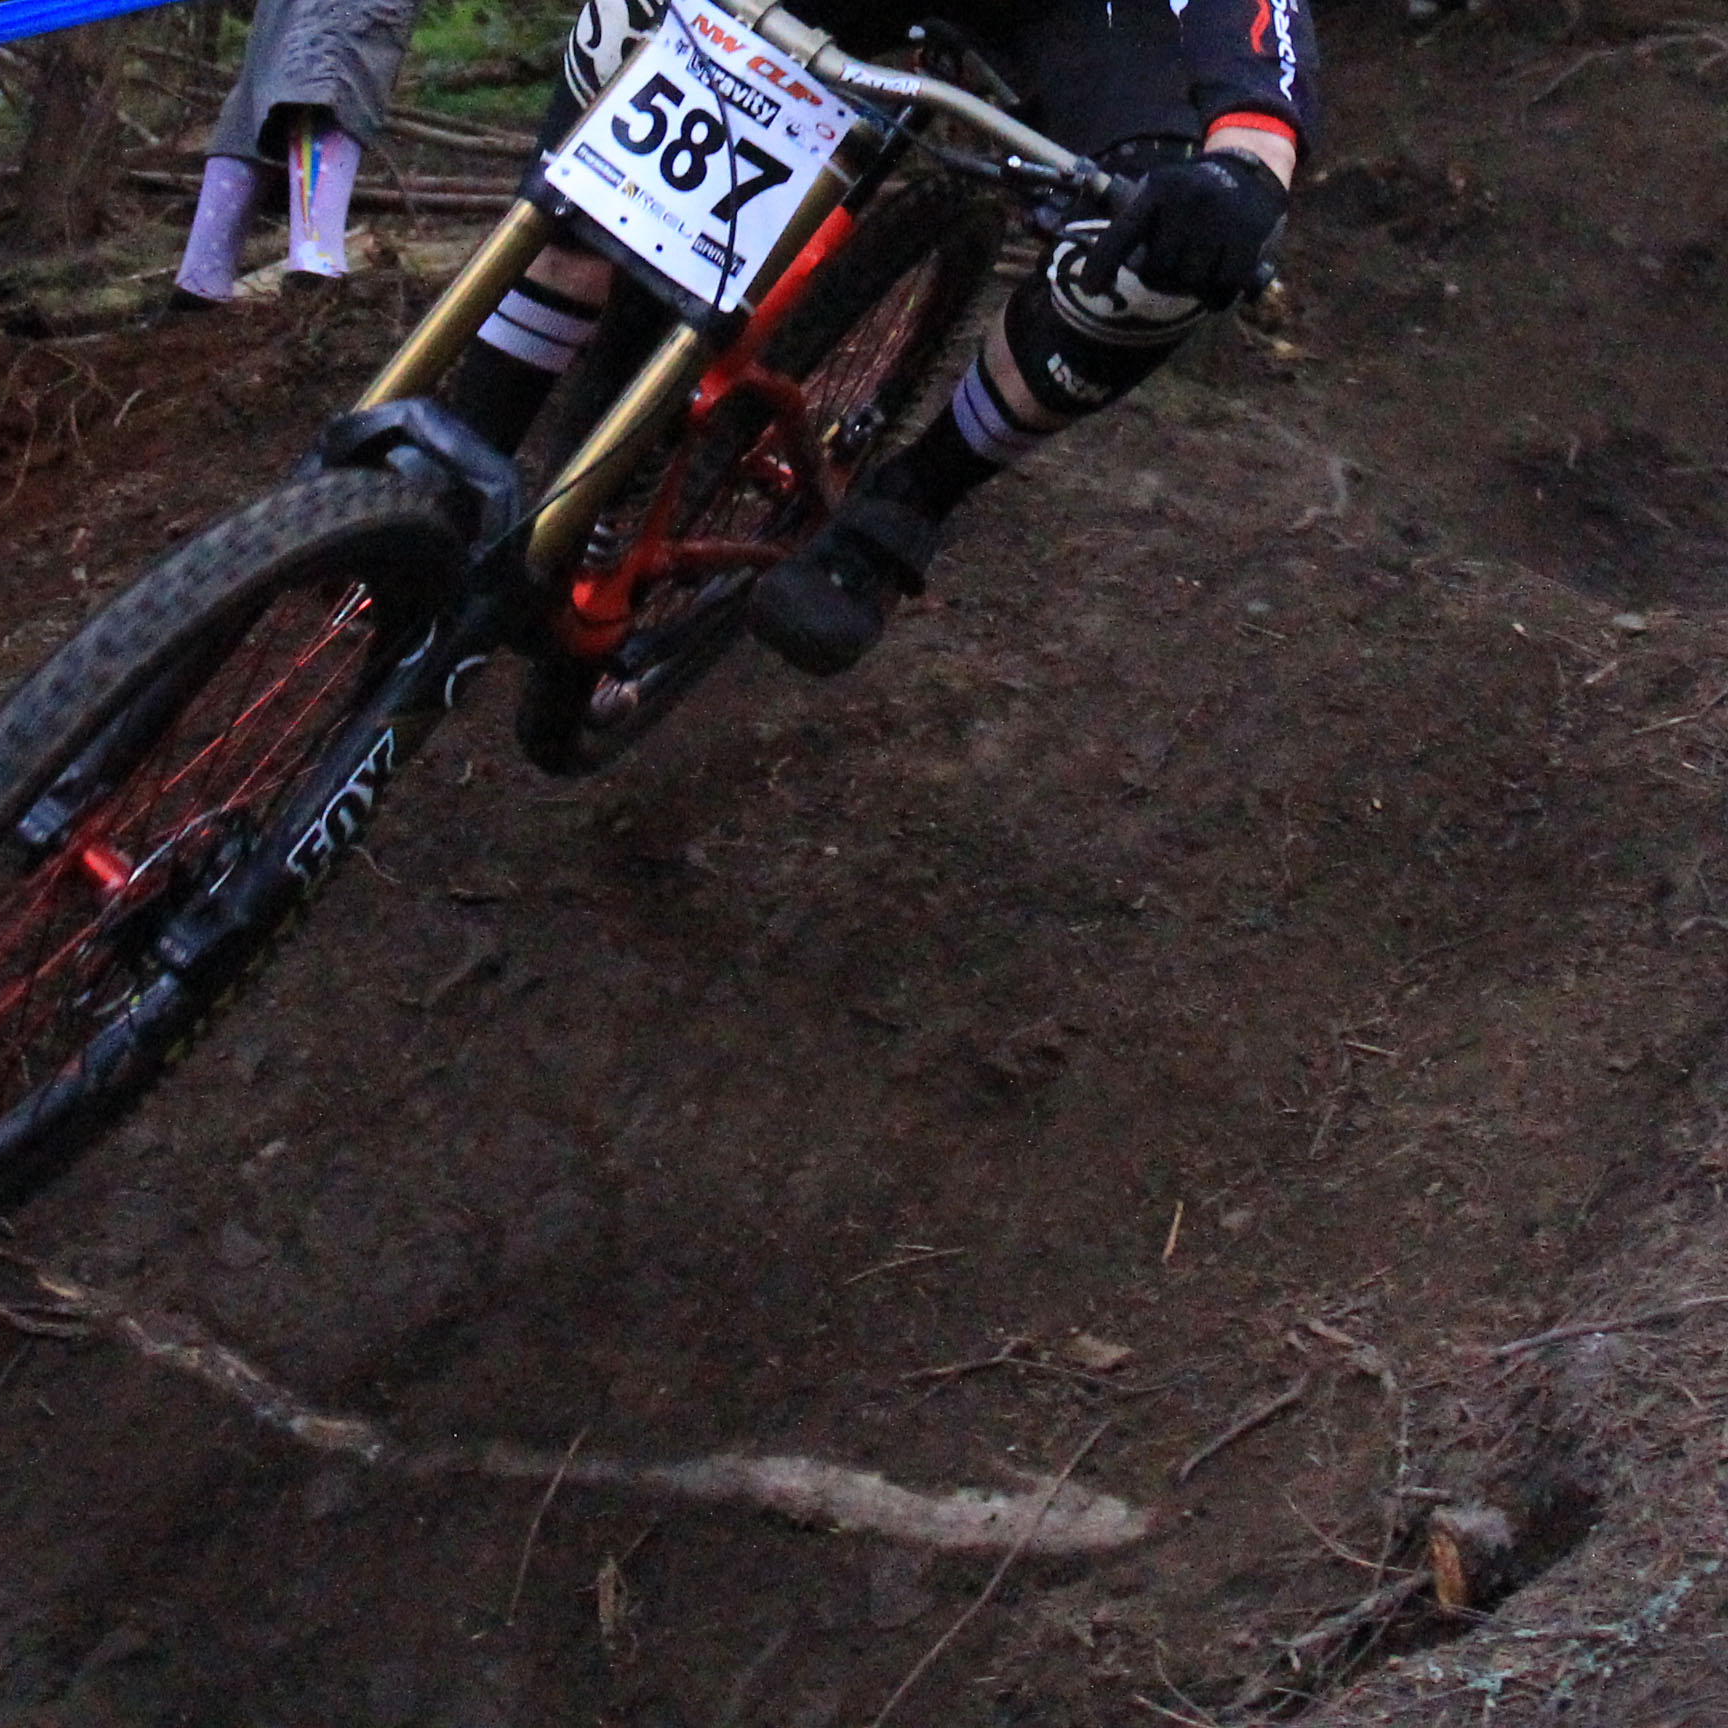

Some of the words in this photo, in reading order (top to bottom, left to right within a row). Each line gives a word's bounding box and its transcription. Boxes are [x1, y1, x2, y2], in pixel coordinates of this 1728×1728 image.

[690, 13, 747, 53] NW
[747, 56, 823, 106] CUP
[610, 72, 793, 225] 587
[287, 727, 394, 882] FOX
